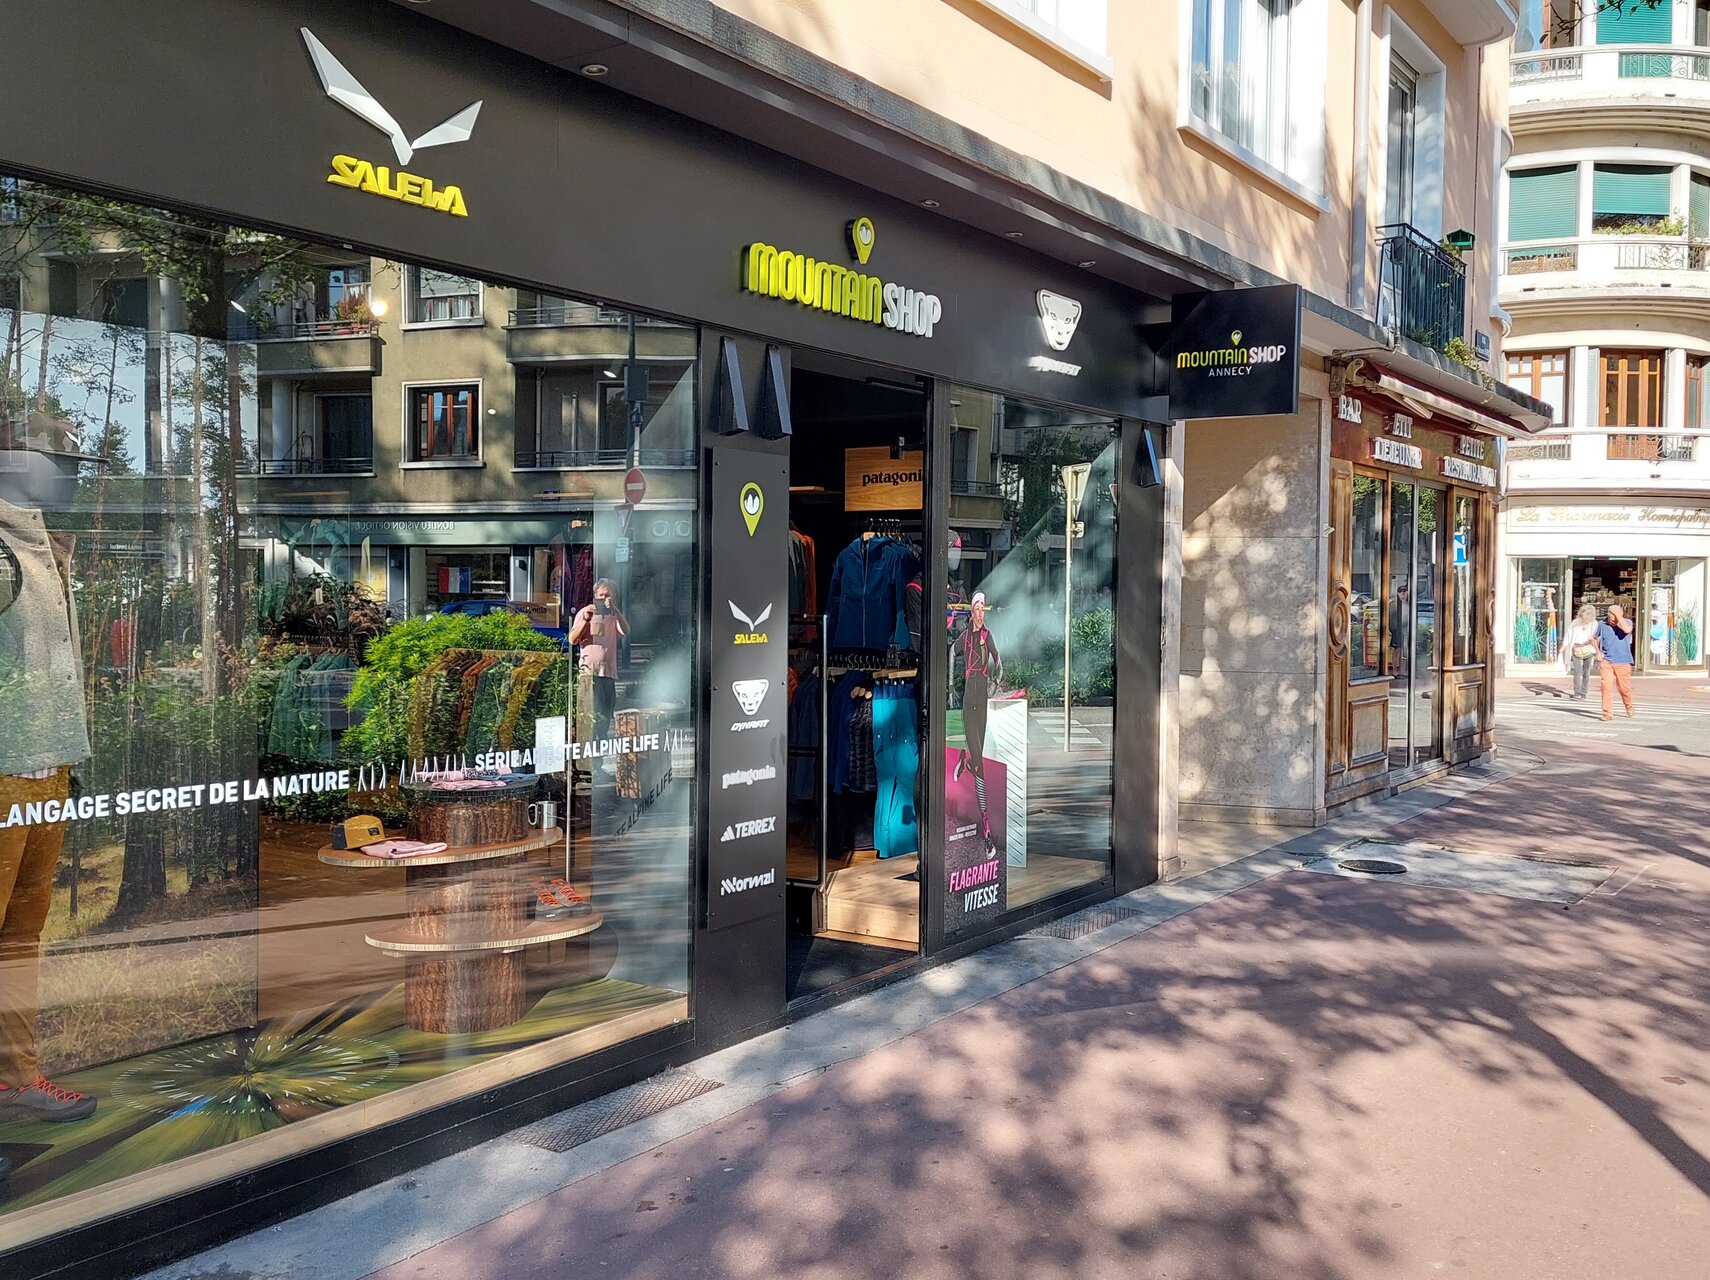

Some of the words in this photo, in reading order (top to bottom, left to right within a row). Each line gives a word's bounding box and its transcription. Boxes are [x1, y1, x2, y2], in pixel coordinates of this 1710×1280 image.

[327, 154, 468, 217] SALEWA
[748, 242, 882, 324] MOUNTAIN
[883, 282, 942, 338] SHOP
[1177, 348, 1248, 368] MOUNTAIN
[1249, 345, 1287, 364] SHOP
[1208, 366, 1253, 377] ANNECY
[1338, 395, 1362, 424] BAR
[1459, 435, 1485, 460] PETITE
[862, 469, 922, 487] patagoni
[733, 633, 768, 645] SALEWA
[475, 747, 522, 772] SÉRIE
[583, 736, 632, 759] ALPINE
[632, 733, 659, 752] LIFE
[722, 765, 776, 789] patagonia
[115, 785, 205, 815] SECRET
[210, 781, 238, 805] DE
[243, 778, 269, 801] LA
[273, 770, 349, 797] NATURE
[735, 816, 776, 839] TERREX
[949, 860, 999, 893] FLAGRANTE
[964, 883, 999, 913] VITESSE
